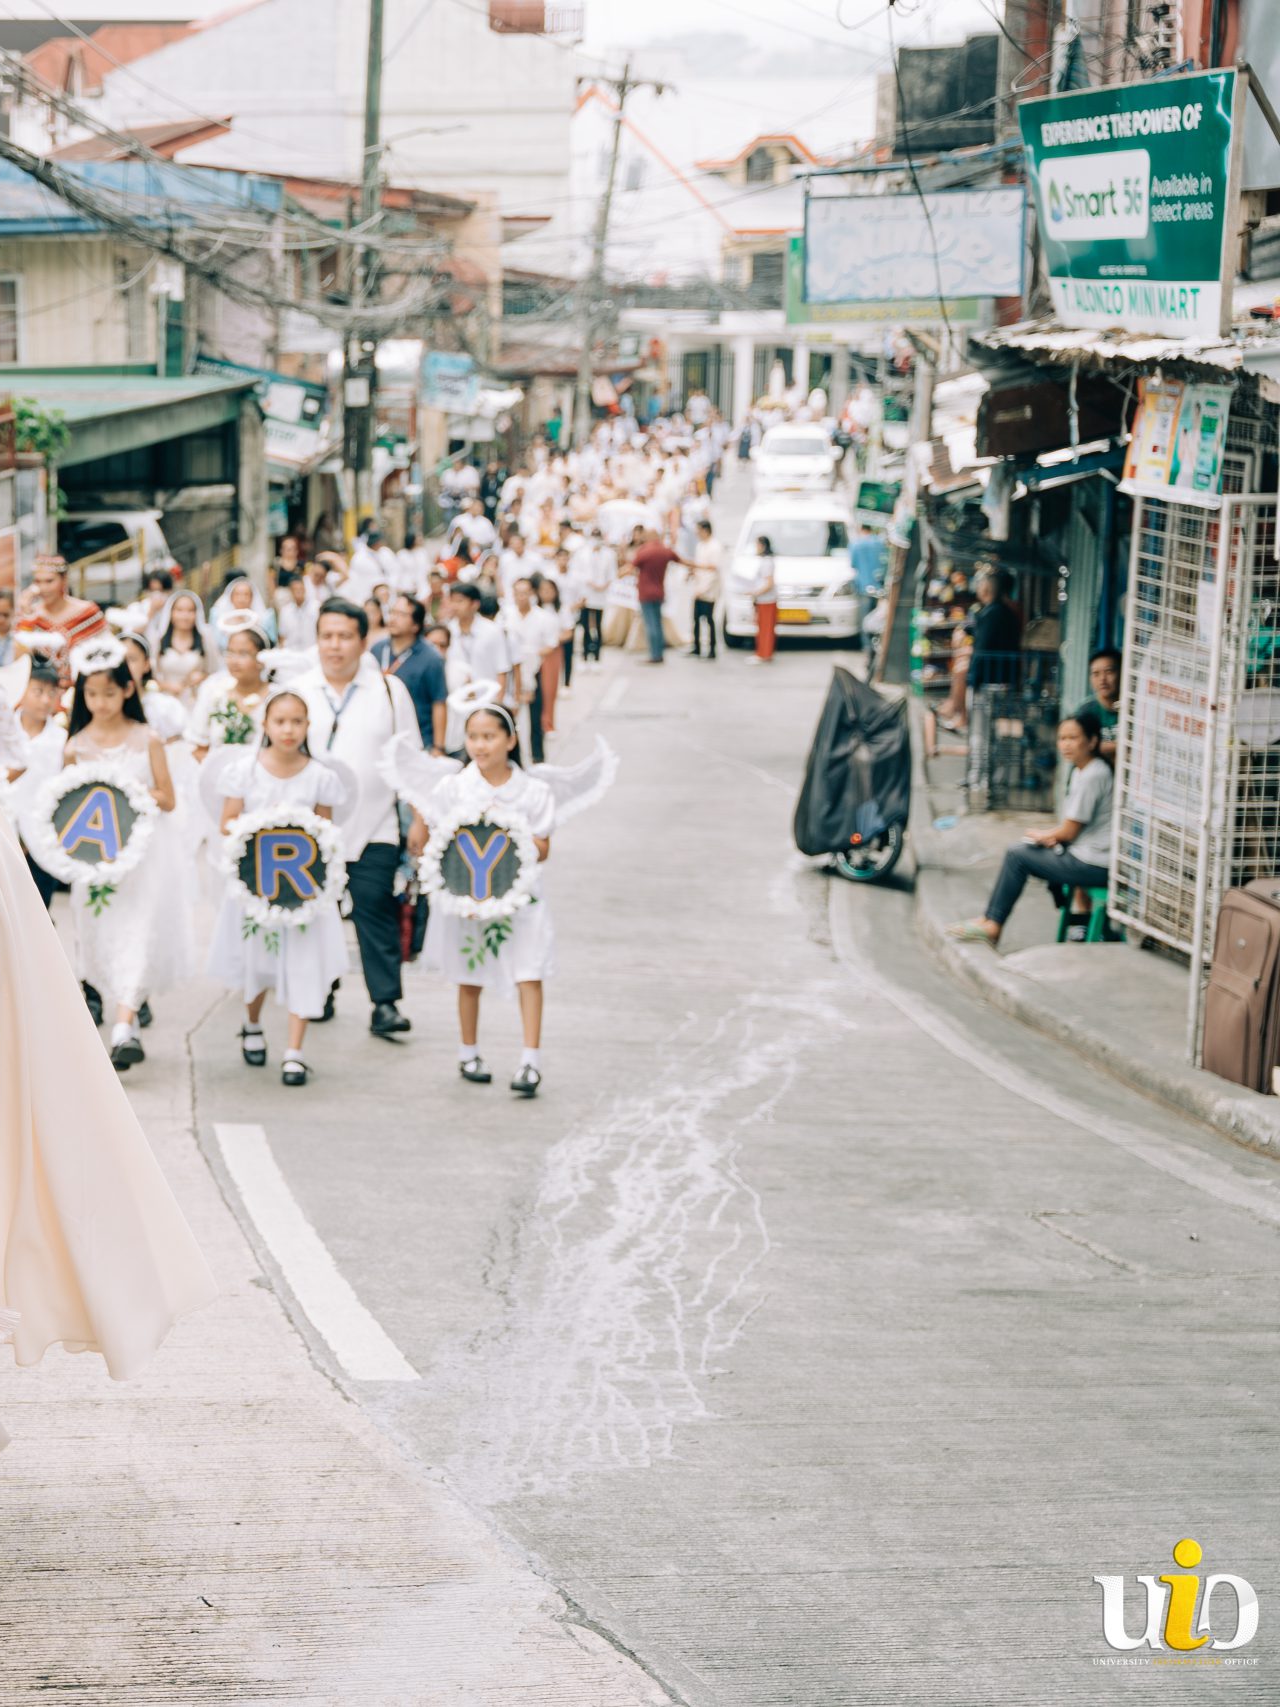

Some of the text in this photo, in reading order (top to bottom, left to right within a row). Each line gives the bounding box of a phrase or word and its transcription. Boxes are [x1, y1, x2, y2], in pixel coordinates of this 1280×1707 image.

[1041, 102, 1204, 147] EXPERIENCE THE POWER OF
[1063, 180, 1118, 219] Smart
[1151, 170, 1212, 198] Available in
[1151, 200, 1214, 222] select areas
[1073, 284, 1124, 315] ALONZO
[57, 786, 123, 864] A
[255, 828, 318, 901] R
[454, 828, 511, 901] Y
